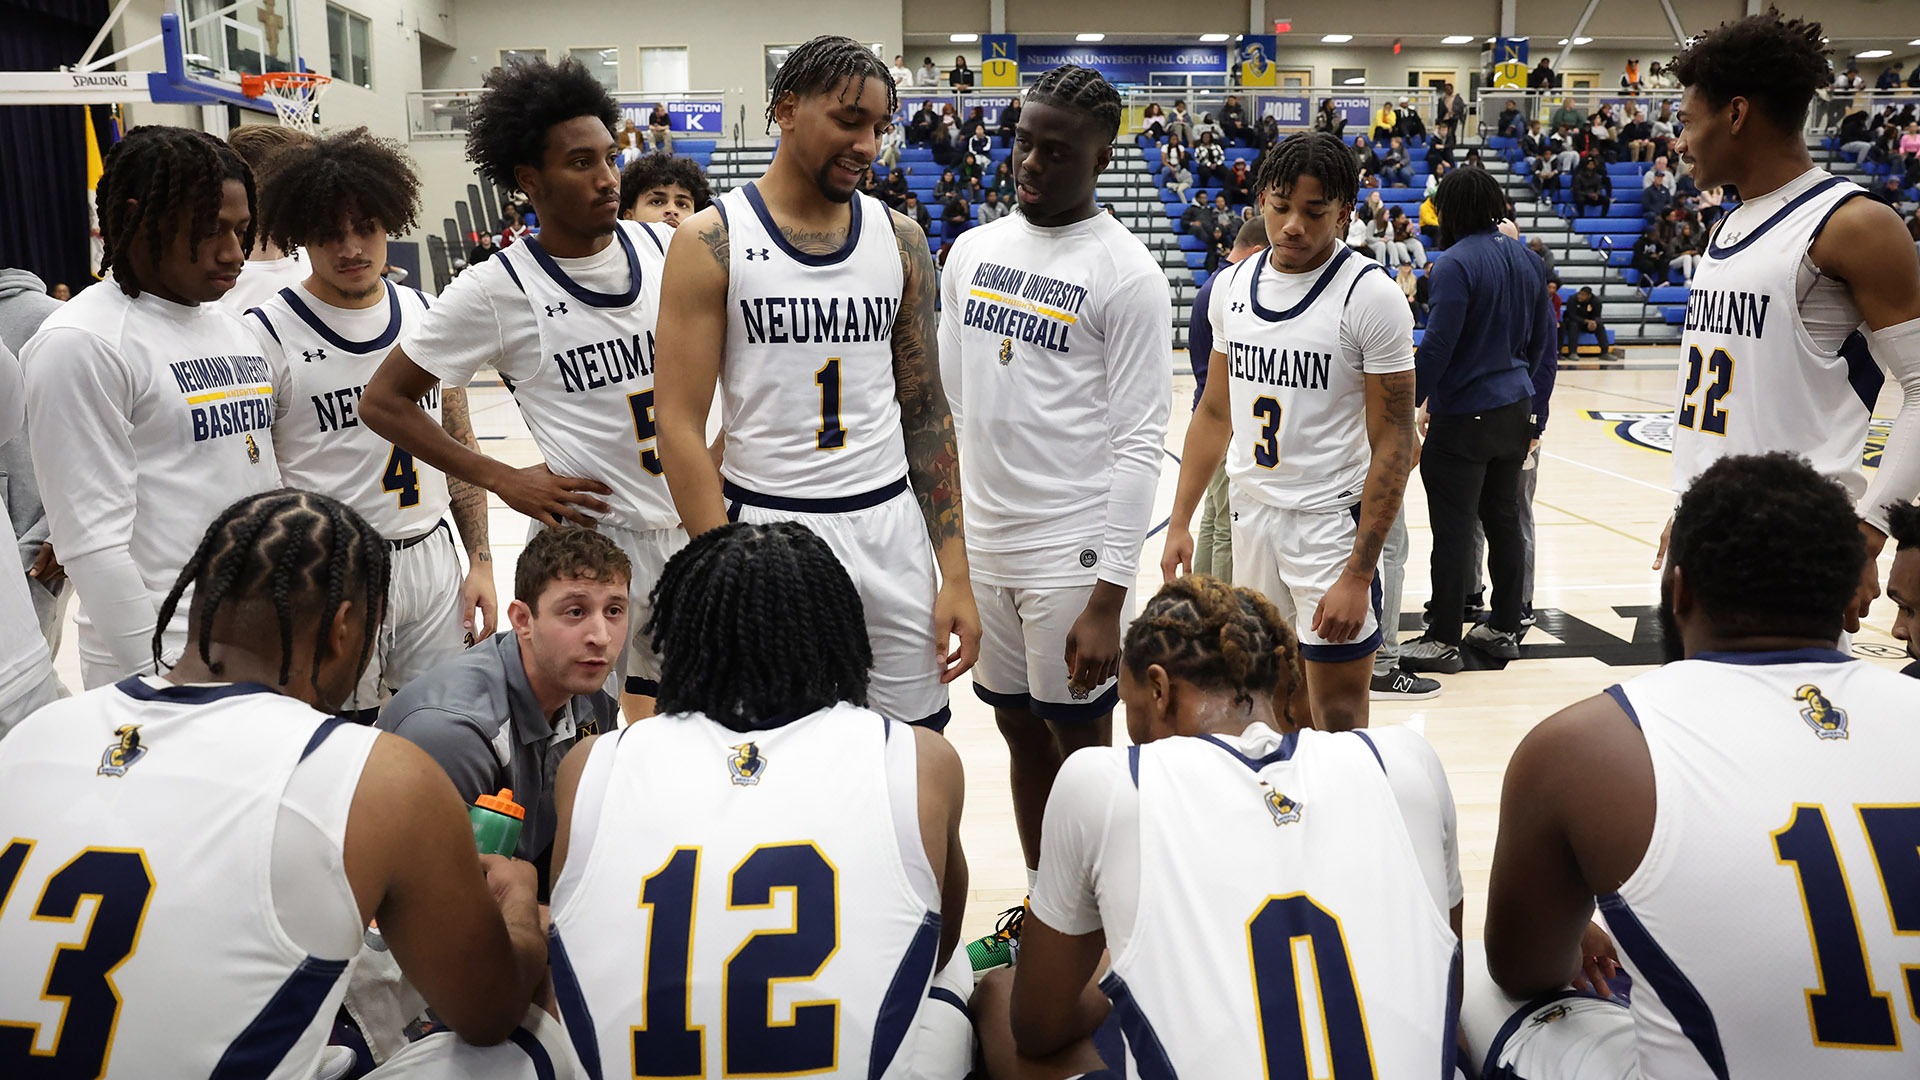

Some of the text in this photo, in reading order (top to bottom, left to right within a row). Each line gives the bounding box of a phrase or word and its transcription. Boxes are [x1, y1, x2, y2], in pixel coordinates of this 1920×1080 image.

[72, 75, 128, 88] SPALDING
[1027, 54, 1220, 65] NEUMANN UNIVERSITY HALL OF FAME
[669, 104, 721, 113] SECTION
[686, 114, 704, 130] K
[1320, 99, 1369, 108] CTION
[969, 262, 1088, 315] NEUMANN UNIVERSITY
[740, 297, 899, 344] NEUMANN
[963, 299, 1070, 353] BASKETBALL
[1685, 288, 1770, 339] EUMANN
[169, 357, 234, 394] NEUMANN
[1678, 343, 1735, 437] 22
[191, 398, 273, 442] BASKETBA
[814, 357, 849, 451] 1
[1252, 393, 1282, 471] 3
[380, 442, 421, 510] 4
[1392, 675, 1414, 693] N
[629, 839, 841, 1080] 12
[1245, 890, 1380, 1080] 0
